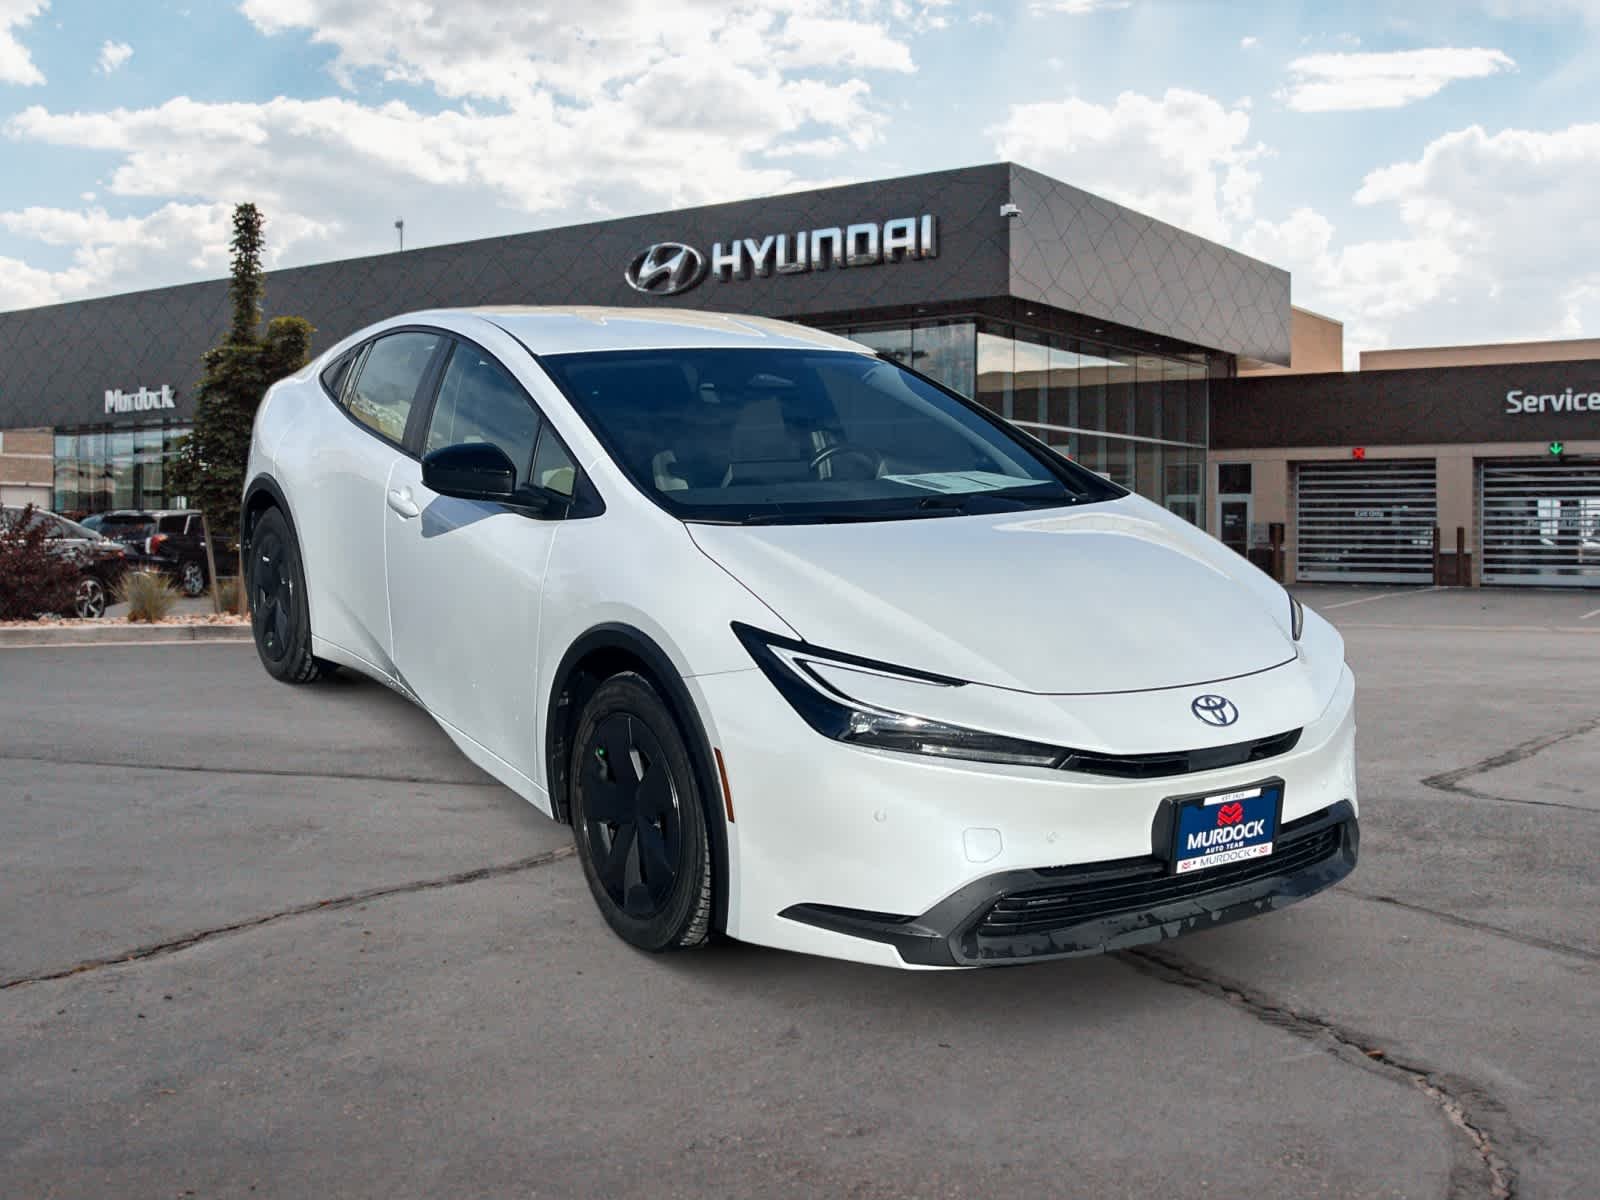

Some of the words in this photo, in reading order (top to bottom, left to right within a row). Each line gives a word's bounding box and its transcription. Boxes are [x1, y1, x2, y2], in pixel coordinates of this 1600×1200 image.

[711, 214, 936, 282] HYUNDAI
[104, 384, 176, 414] Murdock
[1505, 387, 1600, 413] Service
[1186, 819, 1265, 850] MURDOCK
[1205, 845, 1224, 854] AUTO
[1226, 841, 1244, 850] TEAM
[1200, 849, 1251, 867] MURDOCK
